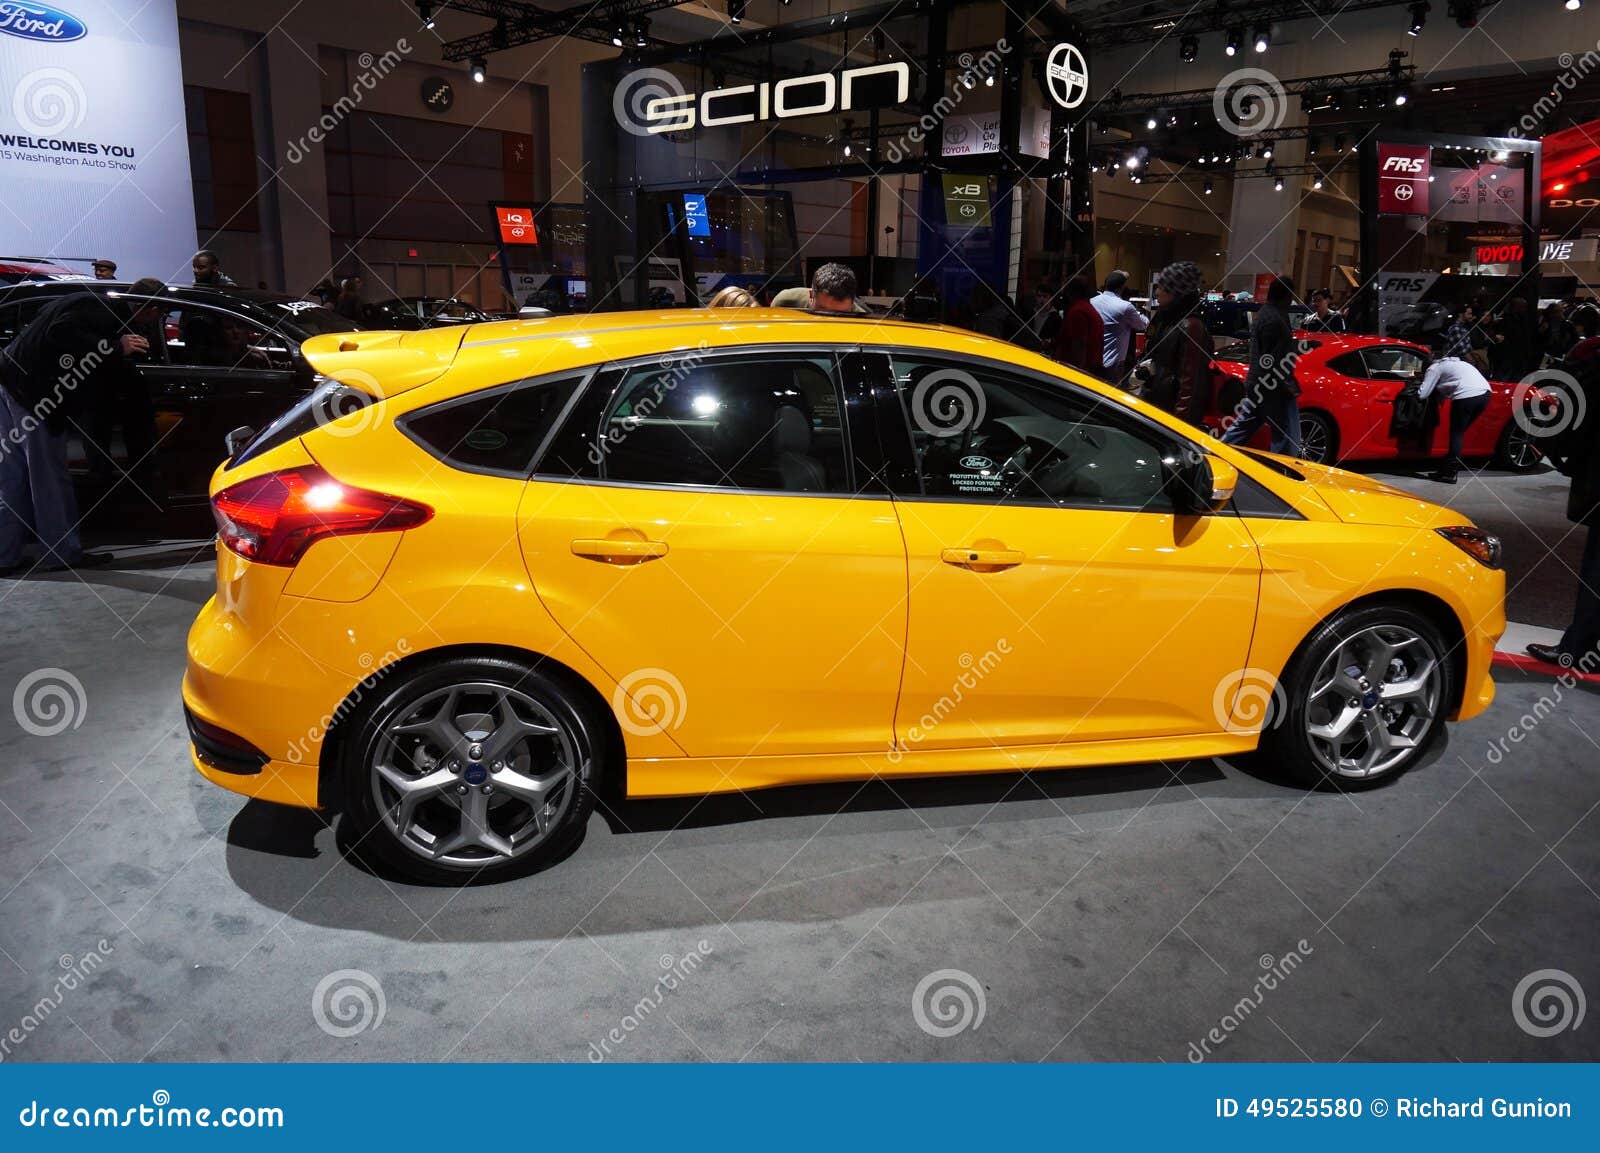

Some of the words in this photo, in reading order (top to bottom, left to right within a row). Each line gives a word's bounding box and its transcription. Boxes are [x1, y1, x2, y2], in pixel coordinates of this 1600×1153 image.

[0, 3, 64, 37] Ford
[646, 61, 909, 134] SCION
[0, 134, 98, 154] WELCOMES
[101, 144, 134, 158] YOU
[14, 152, 79, 165] Washington
[82, 157, 106, 168] Auto
[108, 161, 136, 171] Show
[1382, 156, 1425, 173] FR-S
